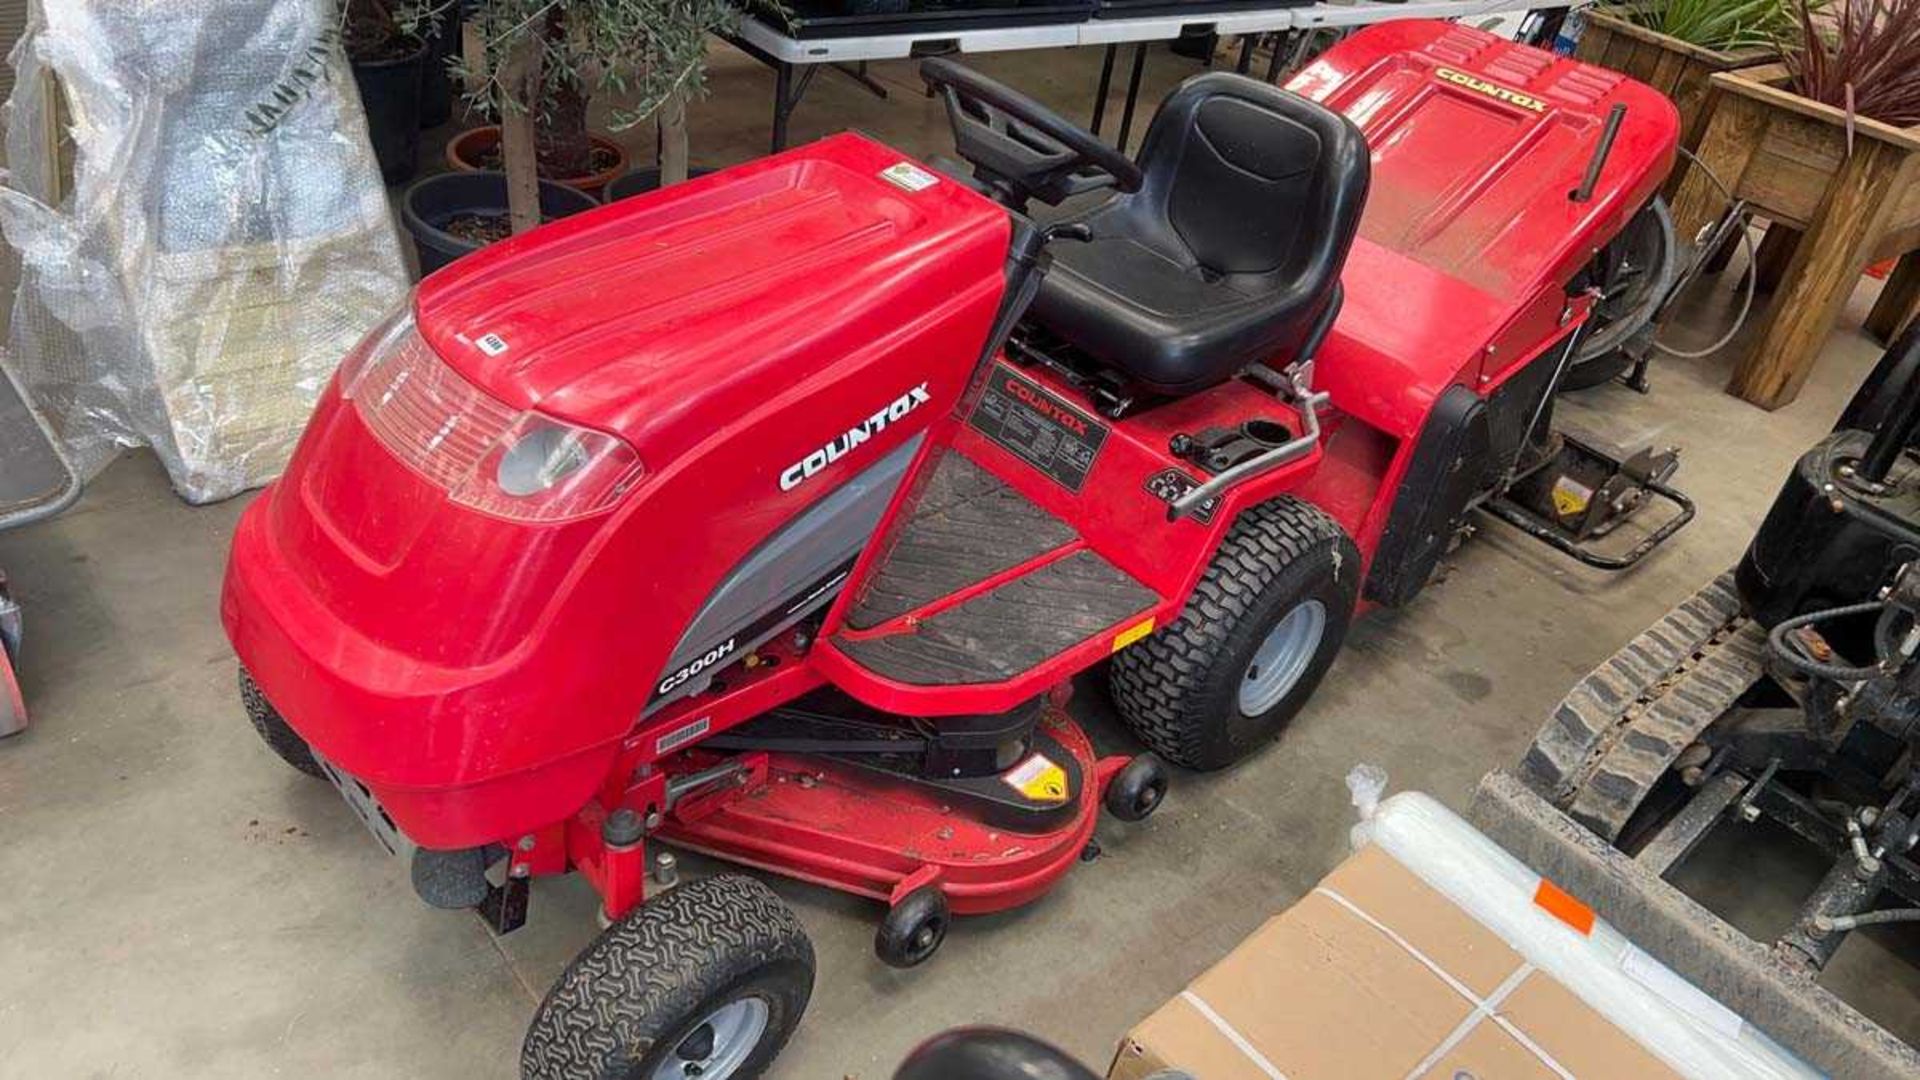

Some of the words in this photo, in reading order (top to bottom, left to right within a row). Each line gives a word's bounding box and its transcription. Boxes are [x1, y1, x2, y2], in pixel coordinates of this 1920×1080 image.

[1435, 67, 1547, 112] COUNTAX
[1005, 379, 1088, 436] COUNTAX
[780, 381, 931, 491] COUNTAX
[659, 638, 735, 694] C300H
